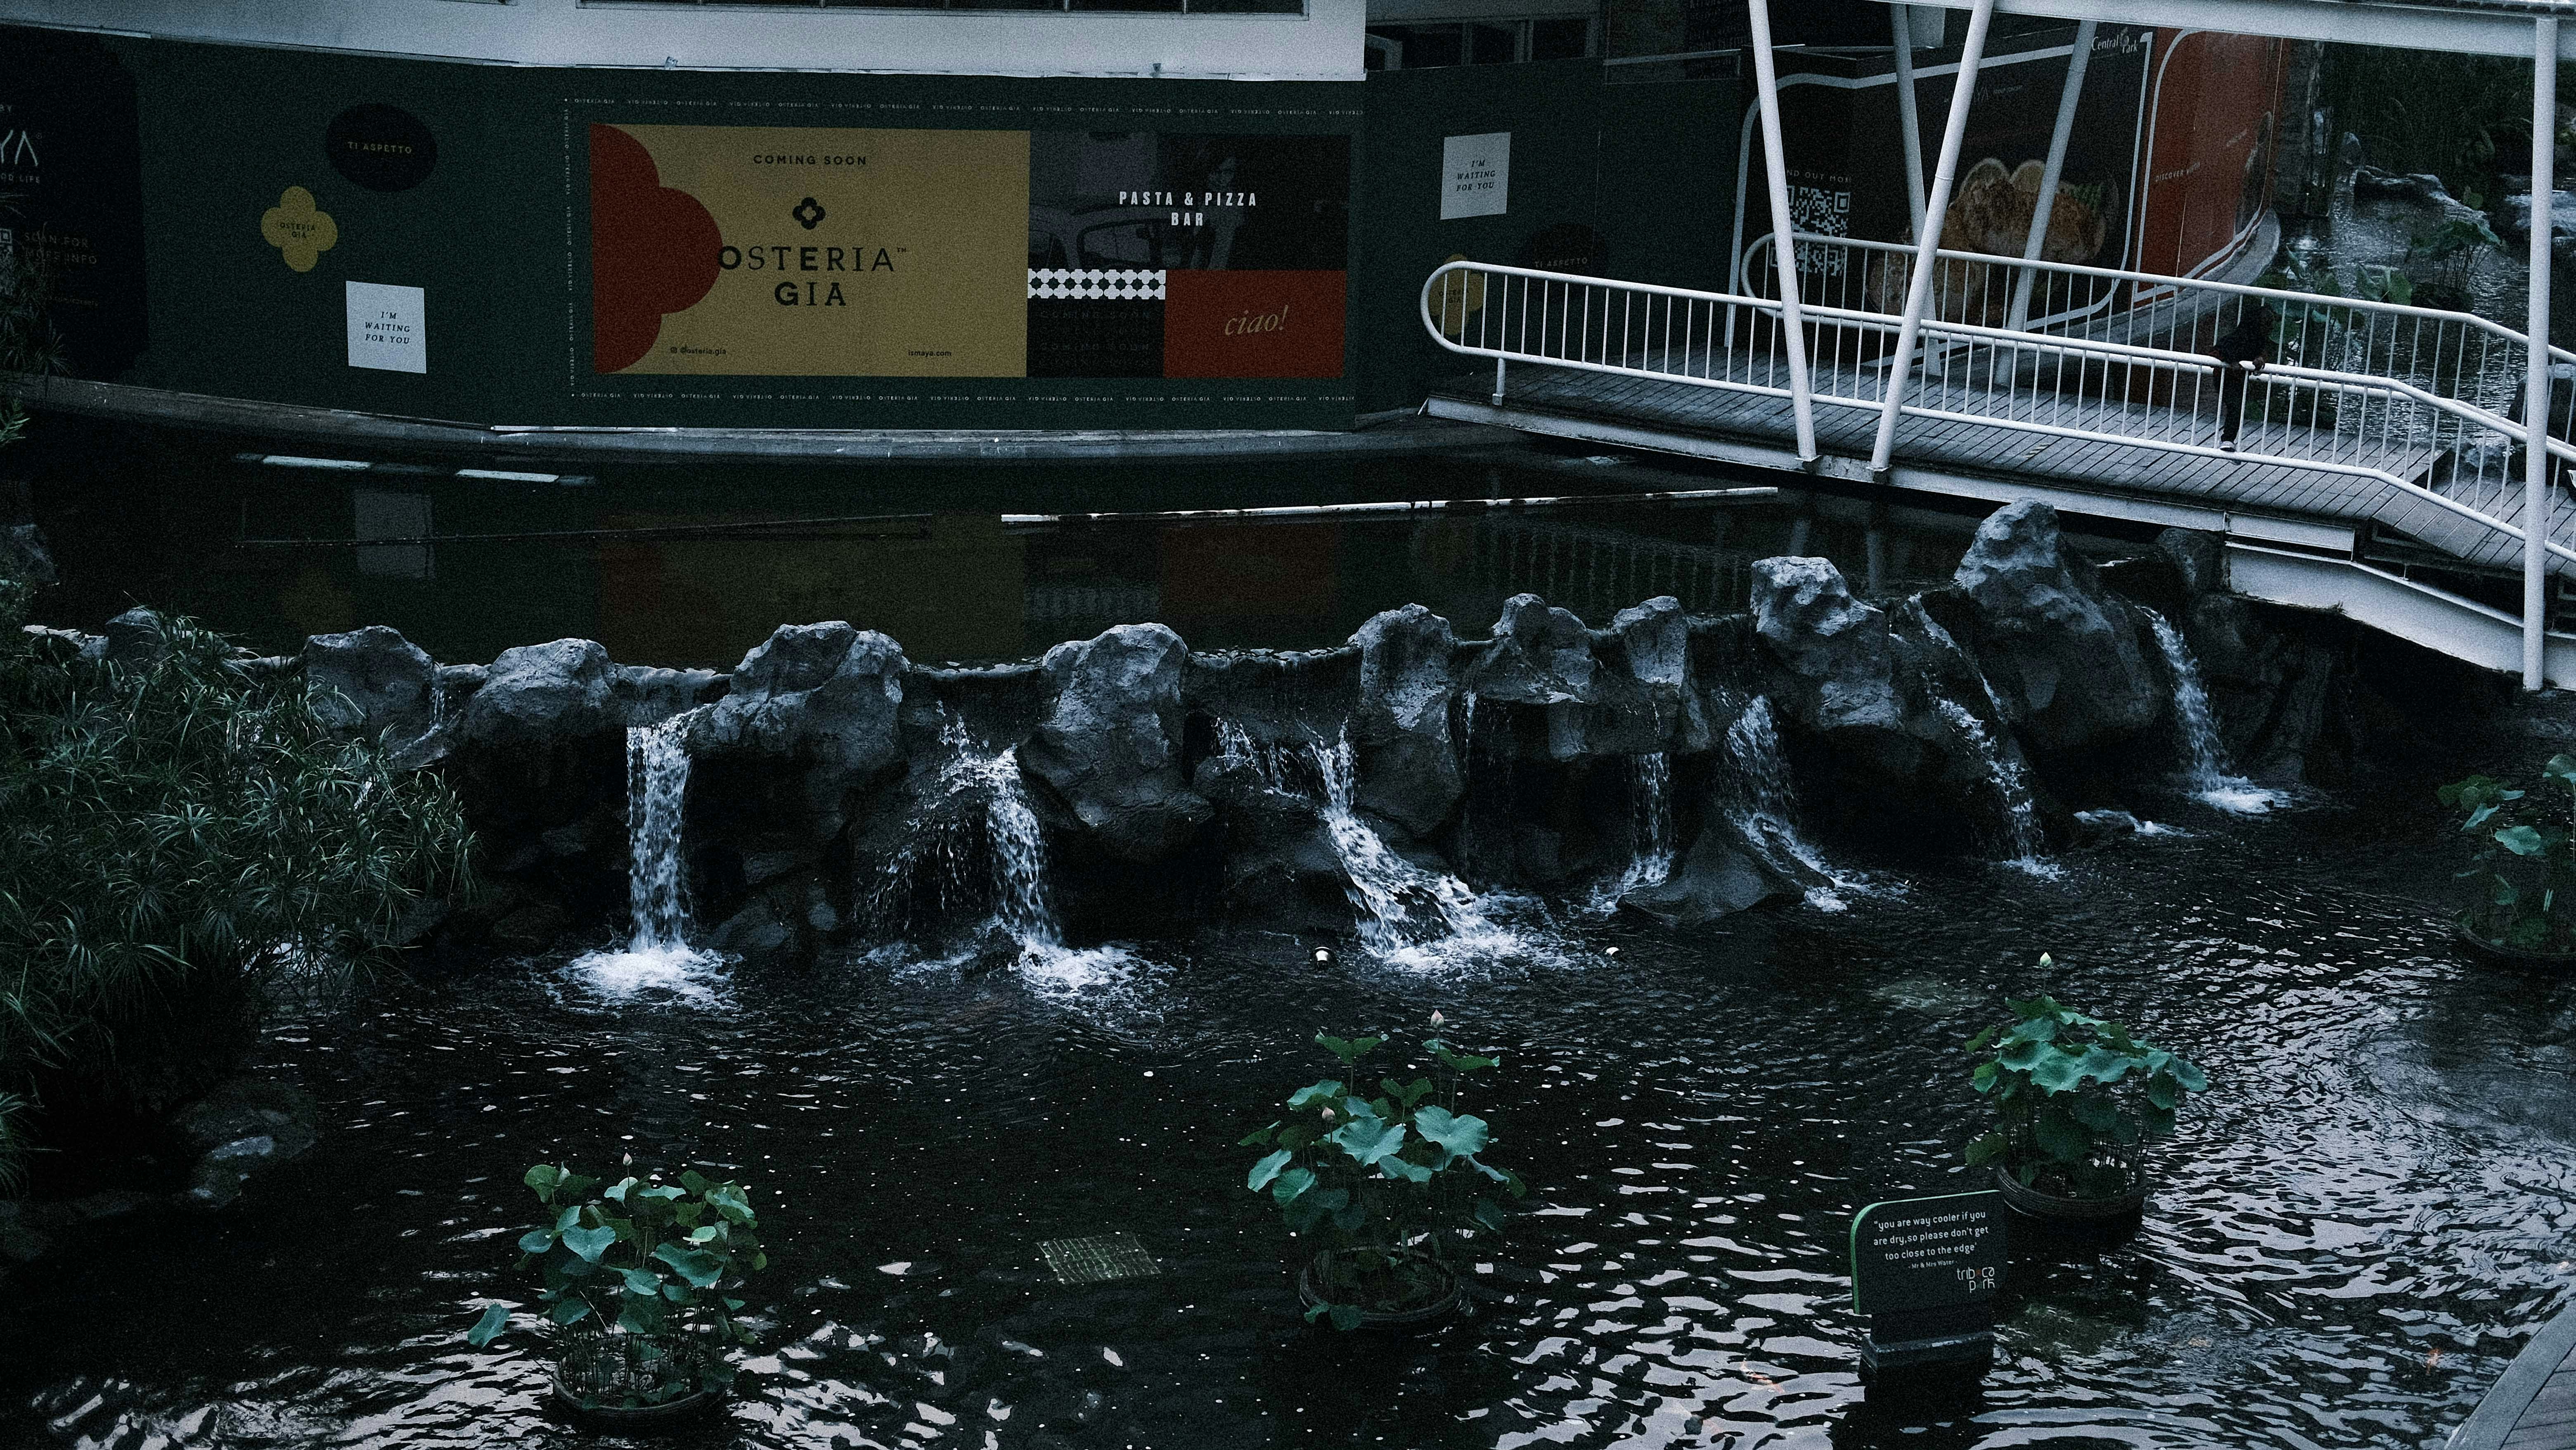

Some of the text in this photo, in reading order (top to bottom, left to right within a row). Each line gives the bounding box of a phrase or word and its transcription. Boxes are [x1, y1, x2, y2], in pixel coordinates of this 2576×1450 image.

[2091, 34, 2119, 51] Central
[348, 141, 412, 154] TI ASPETTO
[753, 155, 866, 165] COMING SOON
[1457, 171, 1495, 180] WAITING
[2155, 169, 2184, 182] DISCOVER
[1478, 182, 1494, 190] YOU
[1120, 191, 1256, 206] PASTA & PIZZA
[1172, 212, 1203, 226] BAR
[64, 236, 89, 247] FOR
[774, 282, 846, 306] GIA
[365, 322, 410, 332] WAITING
[1225, 305, 1288, 336] ciao!
[365, 334, 410, 344] FOR YOU
[680, 347, 726, 356] @osteria.gia
[1913, 1218, 1931, 1227] way
[1933, 1213, 1960, 1223] cooler
[1961, 1211, 1968, 1220] if
[1970, 1212, 1986, 1222] you
[1920, 1231, 1949, 1243] please
[1951, 1227, 1972, 1237] don't
[1975, 1227, 1989, 1237] get
[1901, 1249, 1925, 1258] close
[1938, 1246, 1952, 1254] the
